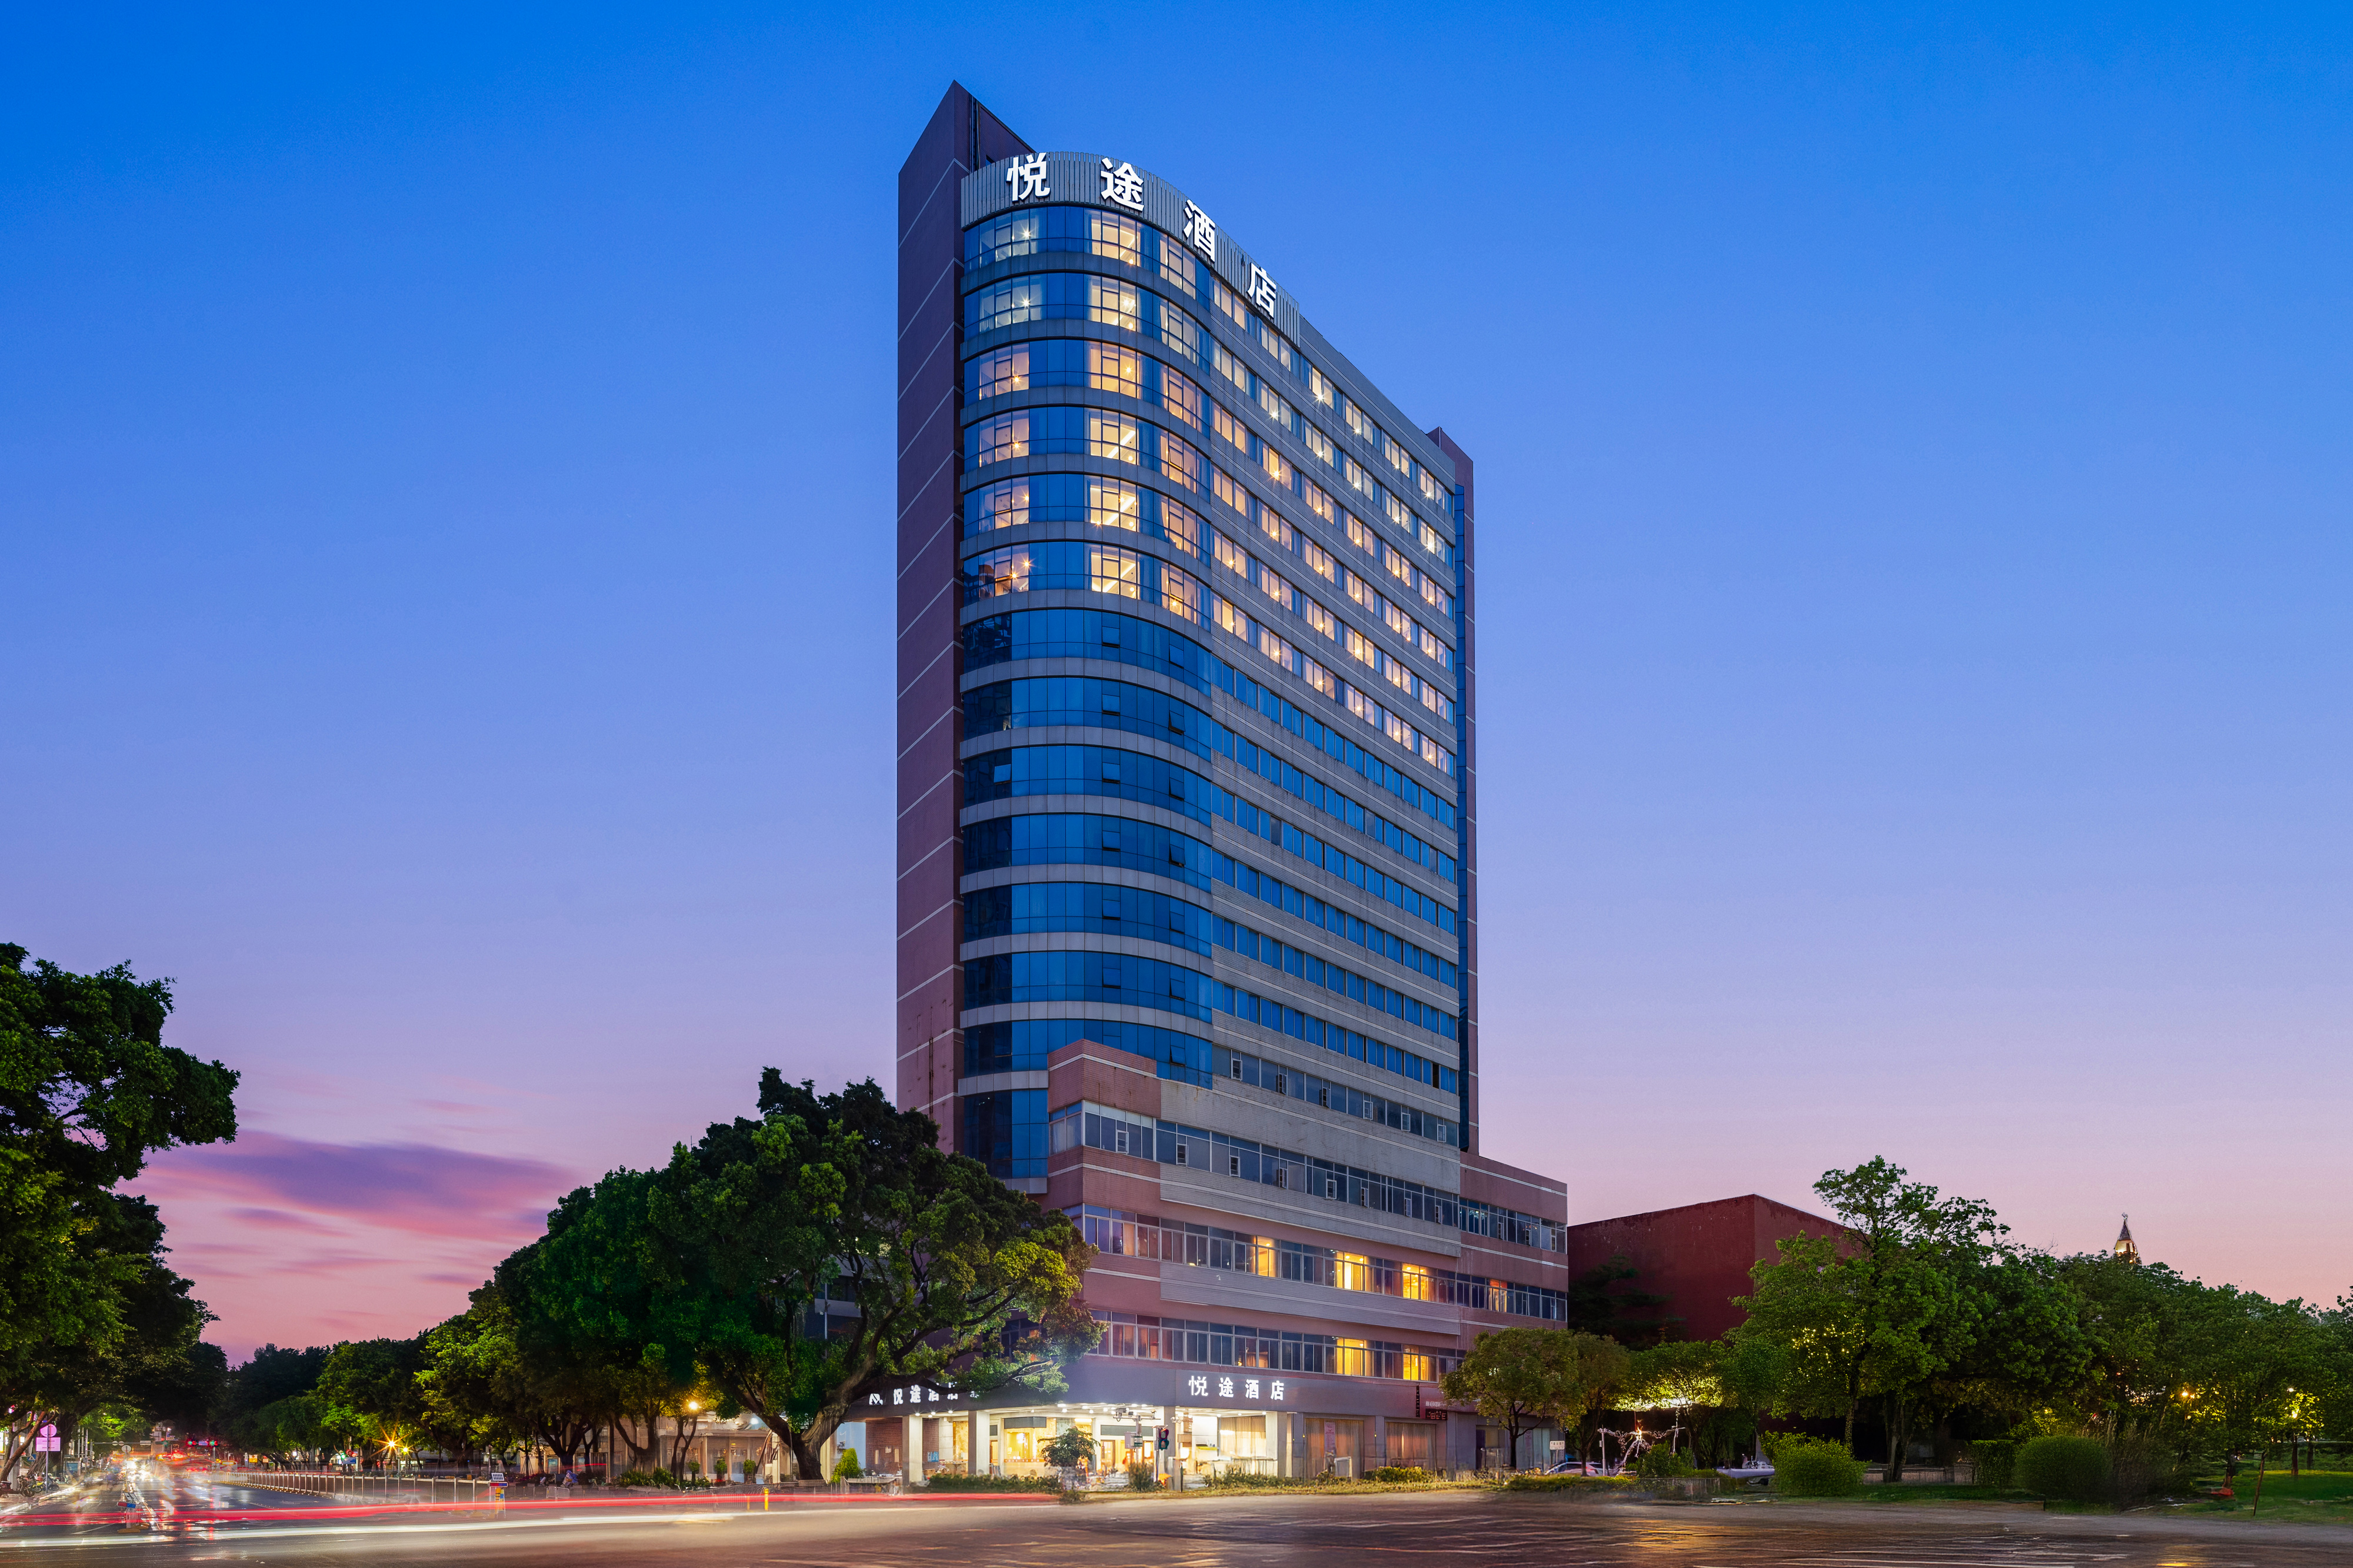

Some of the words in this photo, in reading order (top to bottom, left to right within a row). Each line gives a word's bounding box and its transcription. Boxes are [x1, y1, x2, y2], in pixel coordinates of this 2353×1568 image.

[1006, 152, 1277, 318] 悦途酒店
[1188, 1375, 1285, 1400] 悦途酒店
